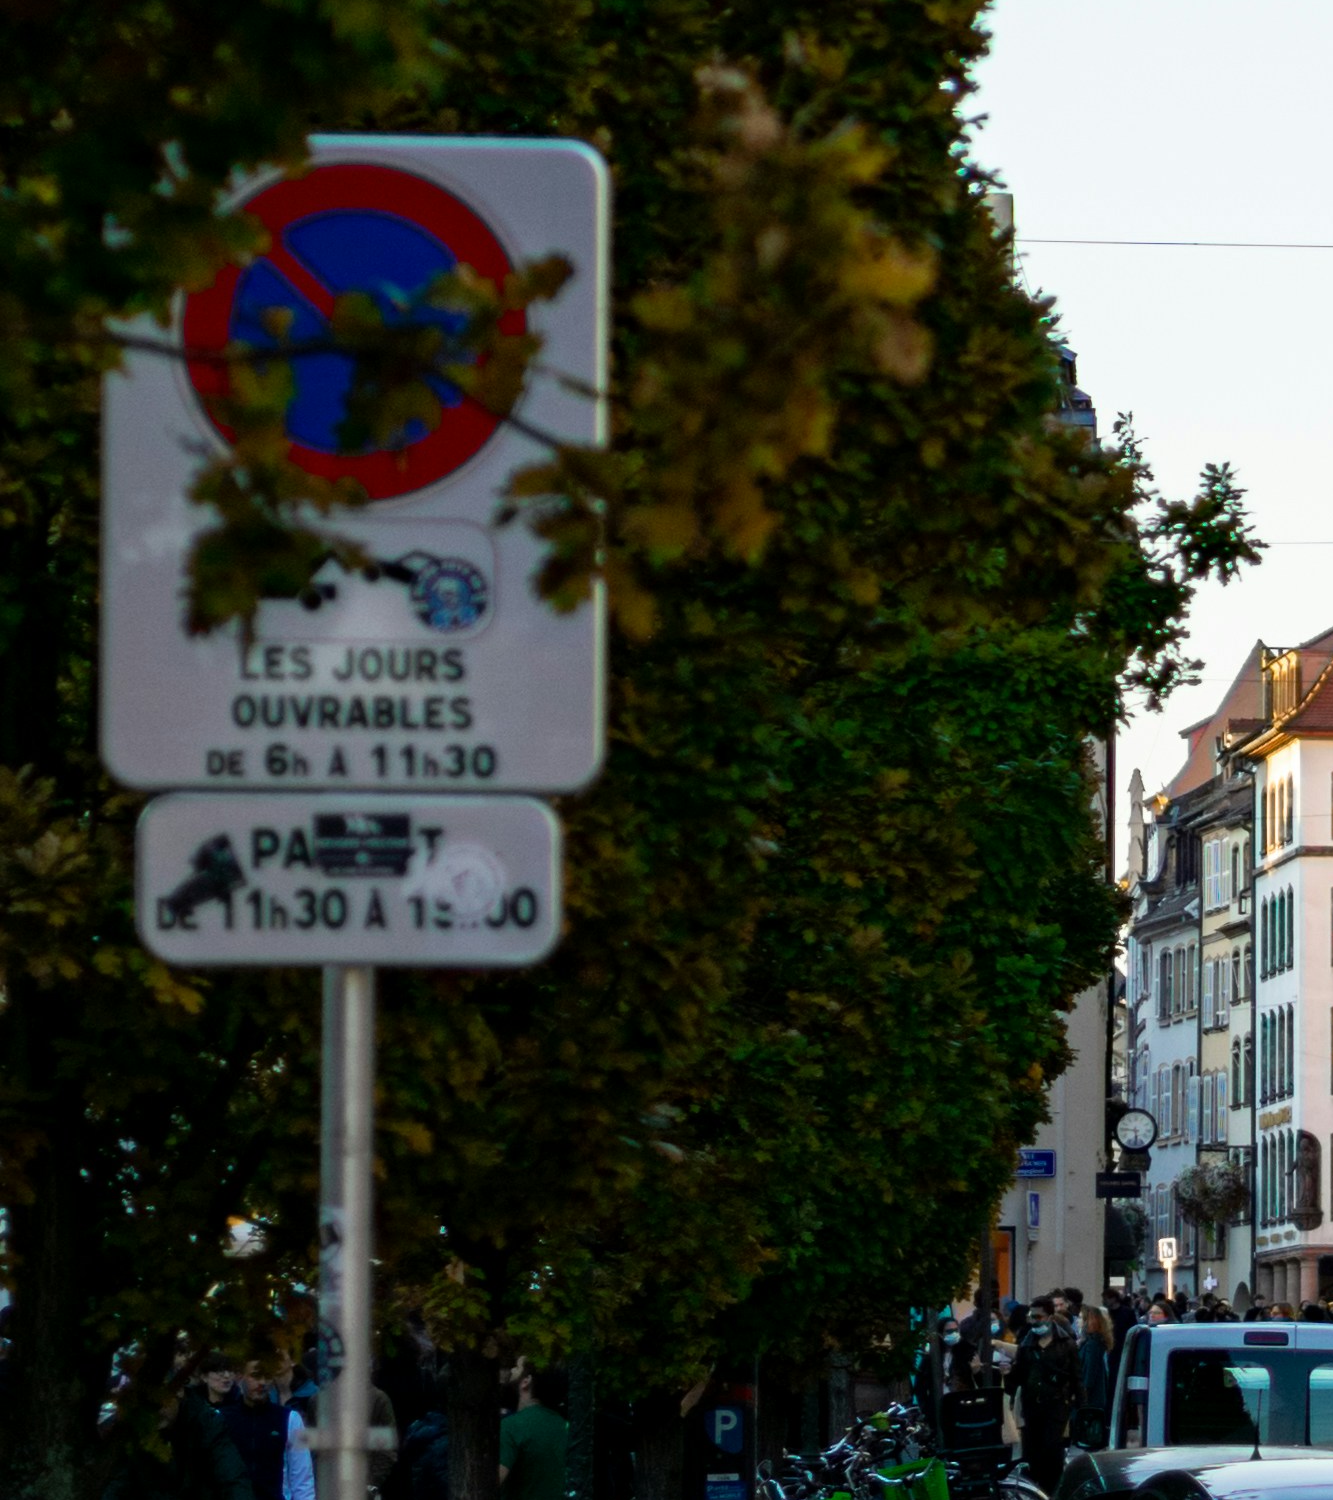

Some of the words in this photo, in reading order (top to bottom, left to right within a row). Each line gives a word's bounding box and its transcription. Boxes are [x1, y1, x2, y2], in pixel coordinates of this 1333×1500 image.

[241, 647, 313, 682] LES
[333, 647, 464, 682] JOURS
[233, 695, 473, 730] OUVRABLES
[206, 750, 244, 777] DE
[266, 744, 310, 777] 6h
[372, 744, 496, 778] 11h30
[252, 828, 444, 871] PAT
[715, 1409, 738, 1444] P
